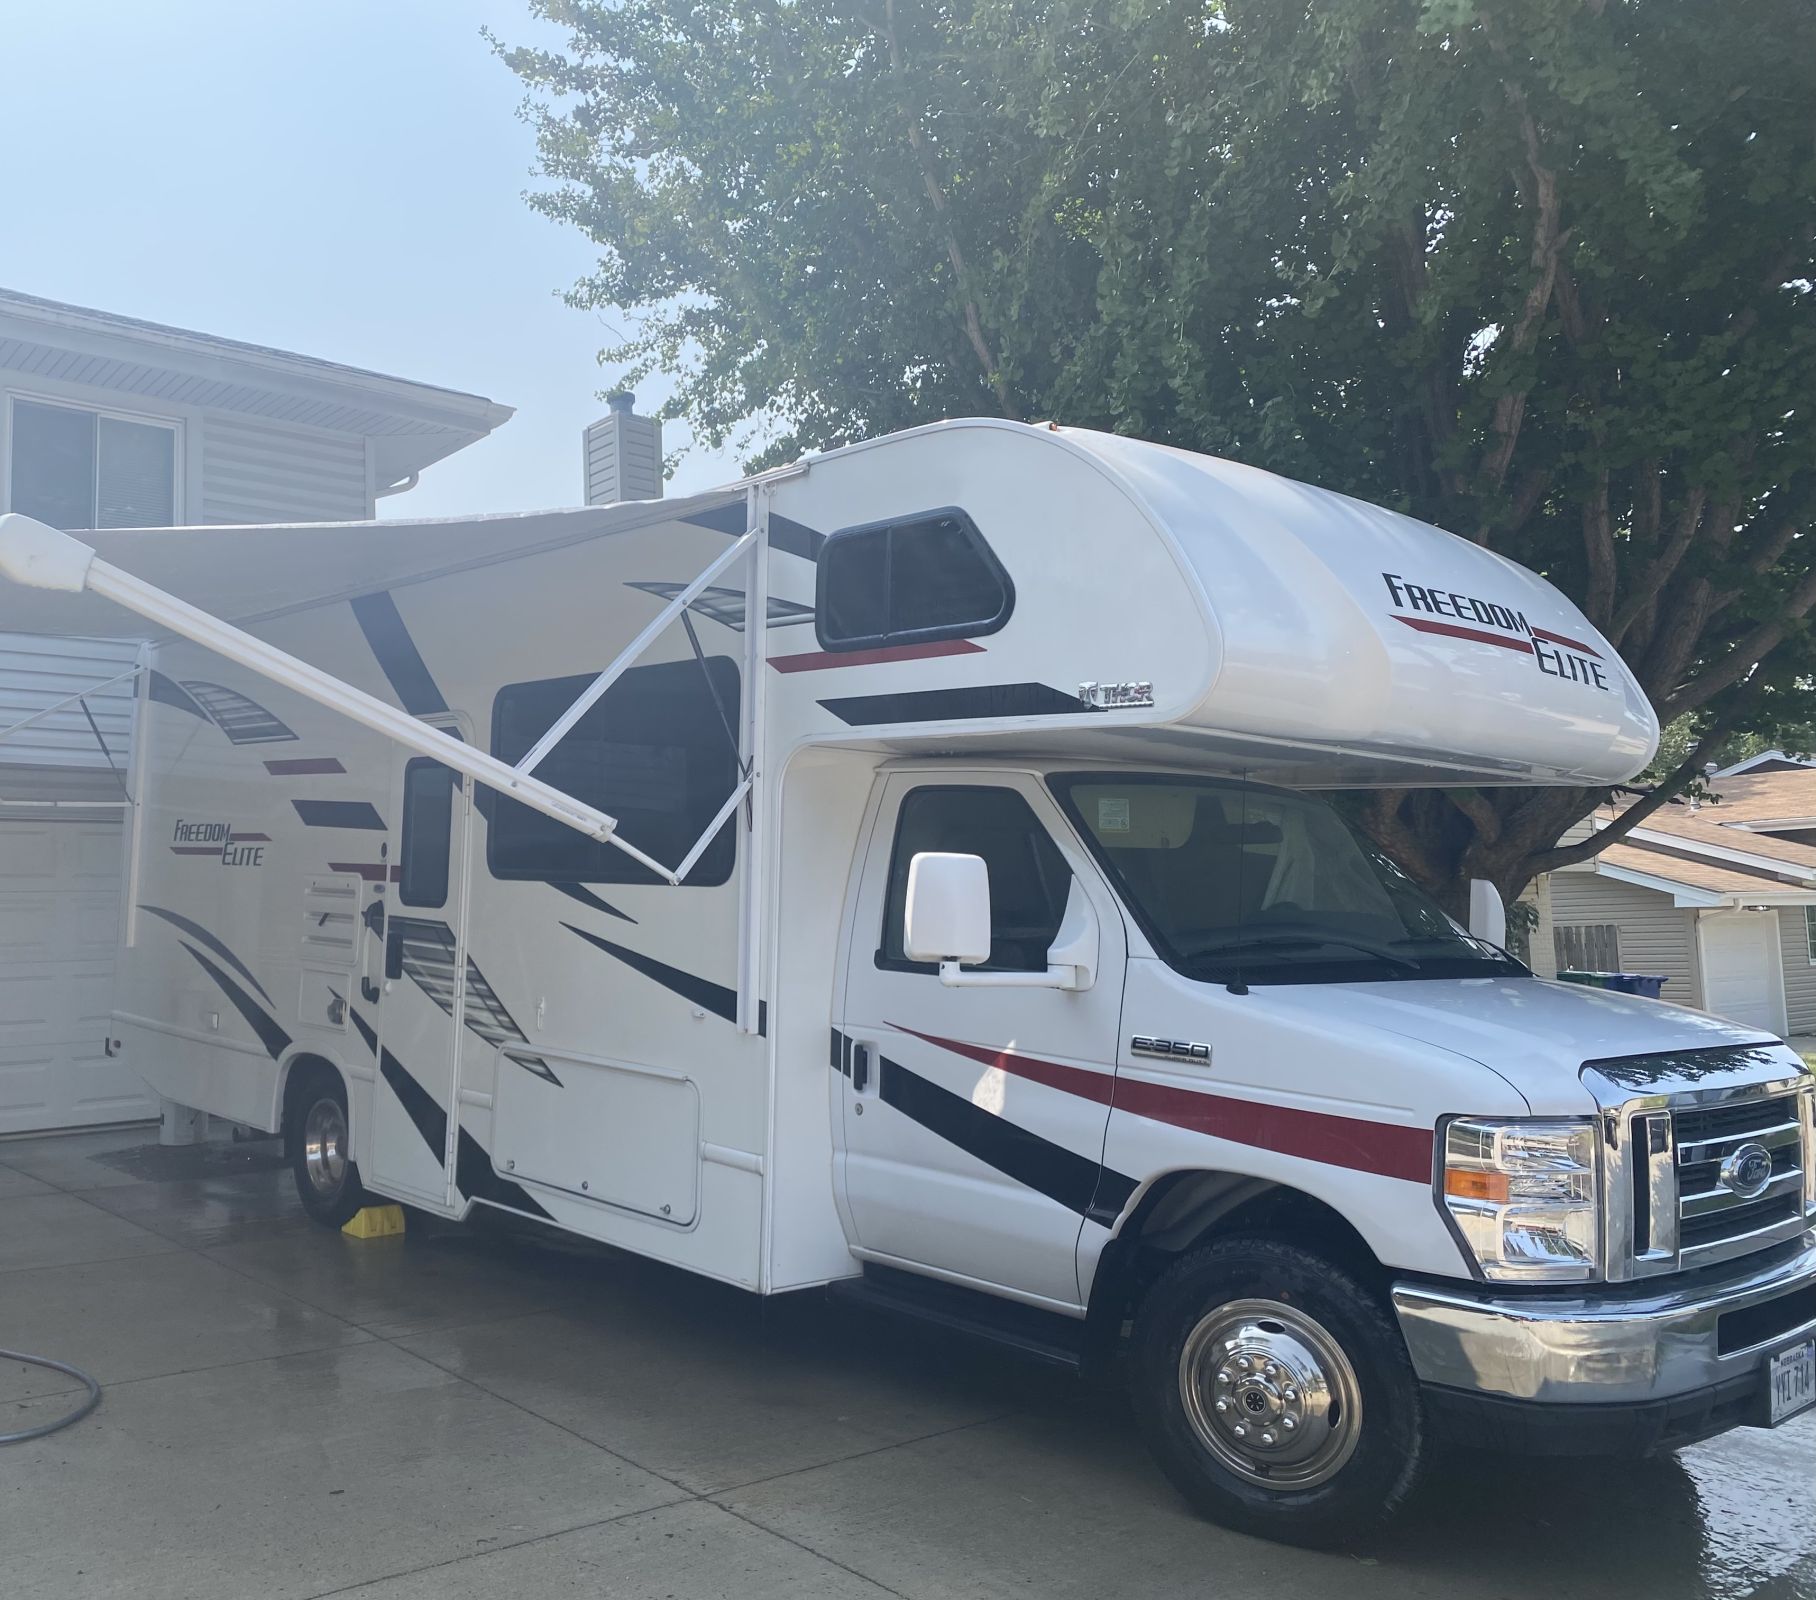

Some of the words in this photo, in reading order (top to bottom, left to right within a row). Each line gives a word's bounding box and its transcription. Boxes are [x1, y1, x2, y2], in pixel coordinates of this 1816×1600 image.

[1382, 572, 1532, 637] FREEDOM
[1531, 636, 1609, 691] ELITE
[174, 819, 231, 842] FREEDOM
[222, 842, 265, 866] ELITE
